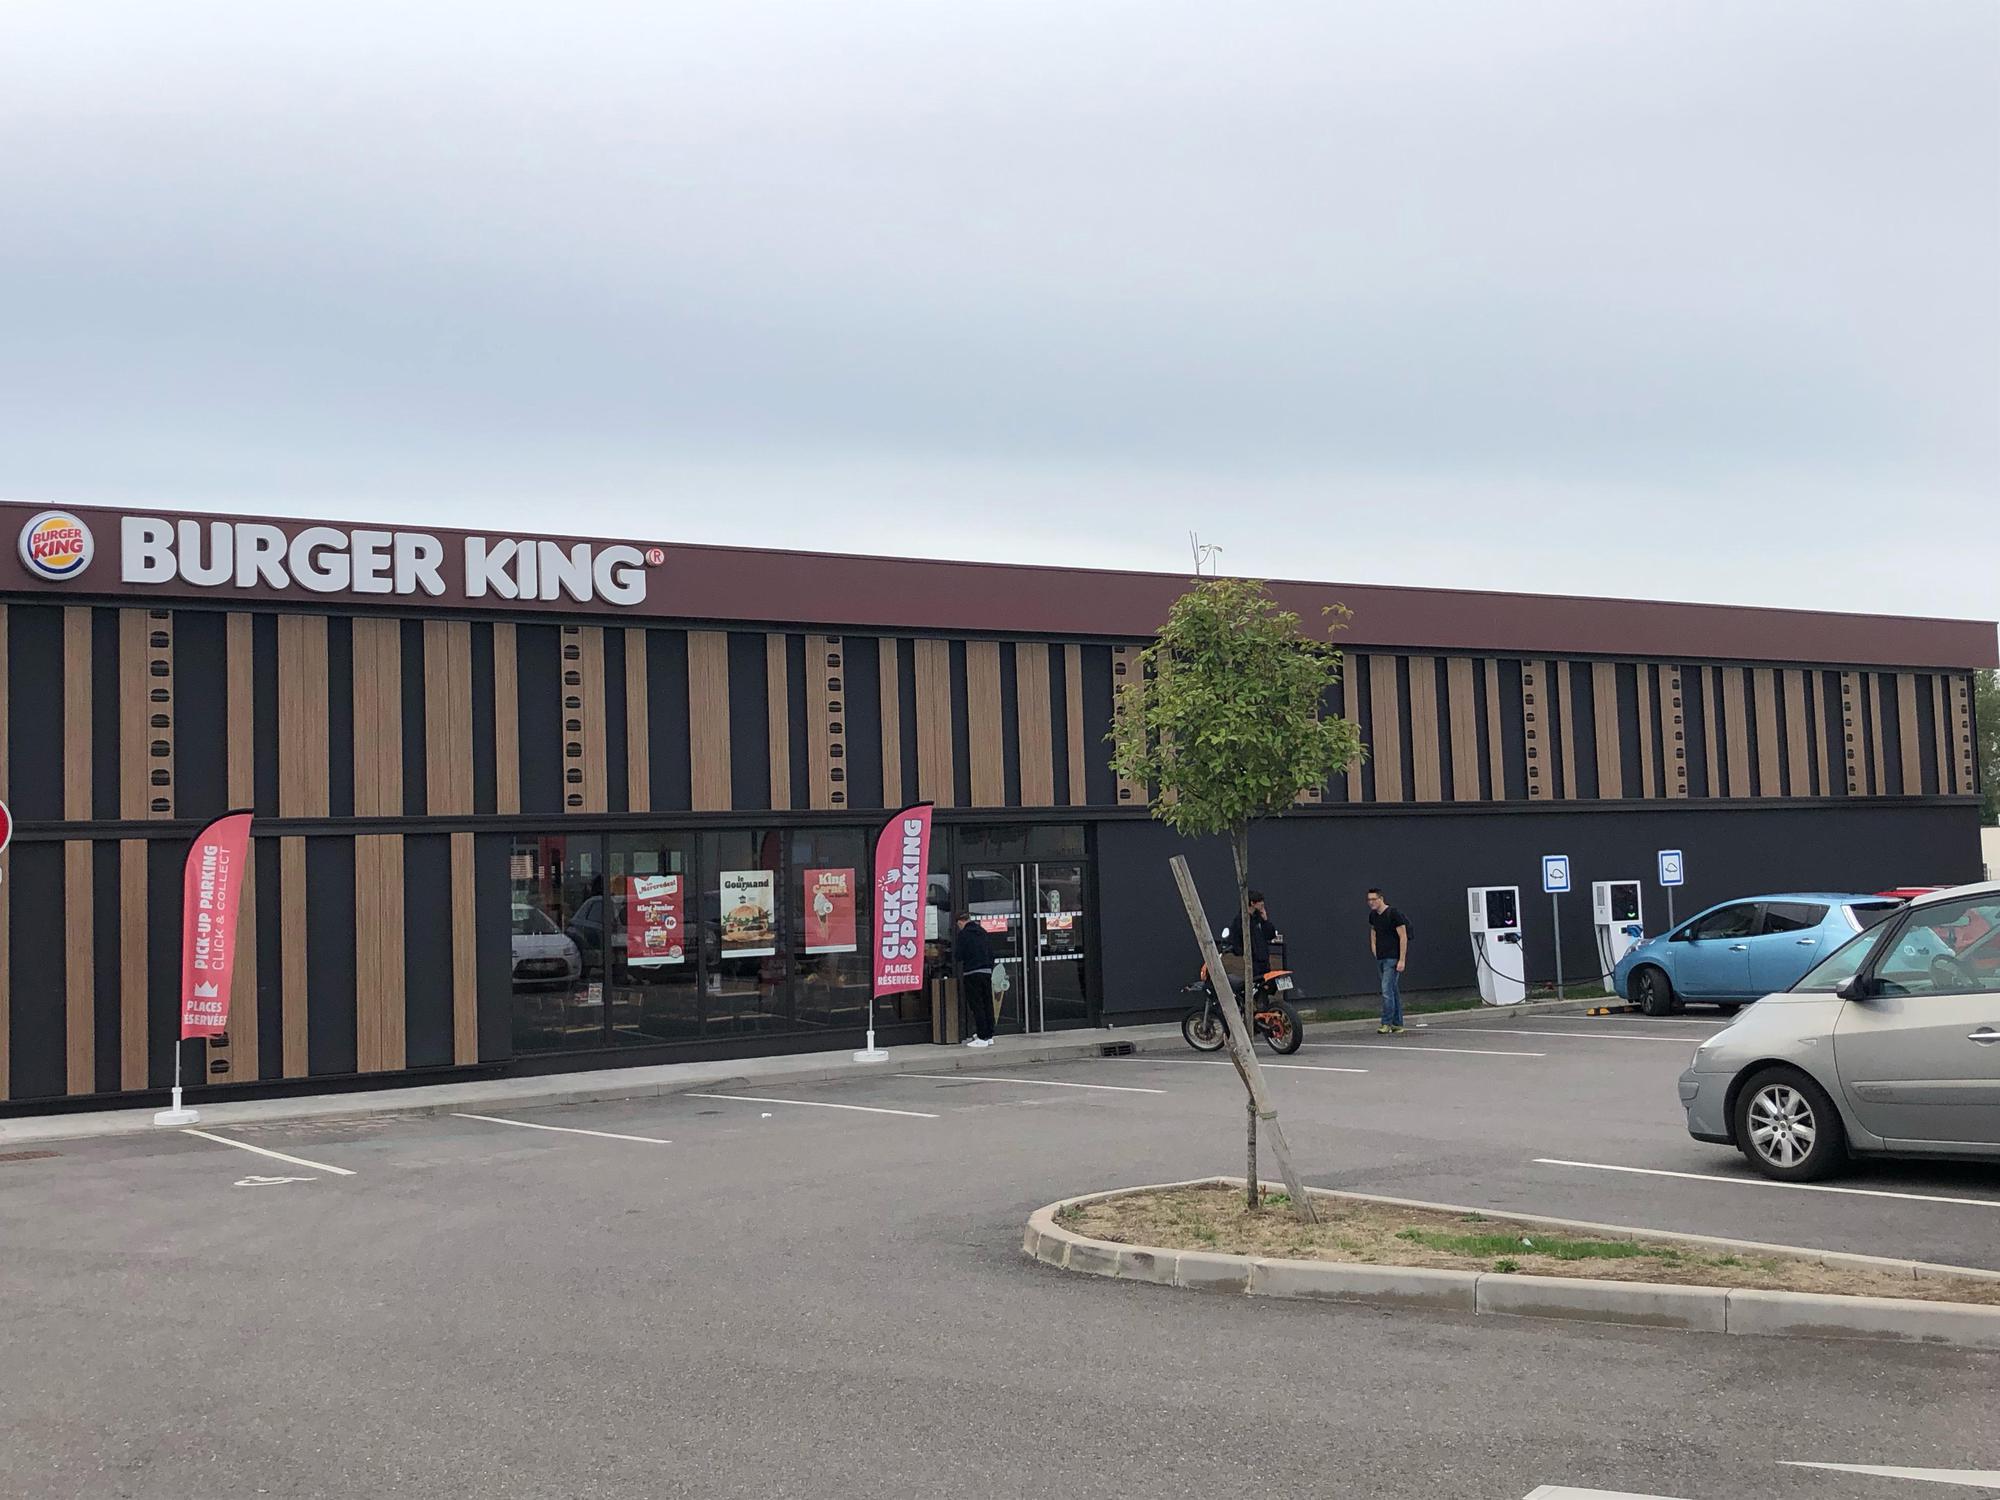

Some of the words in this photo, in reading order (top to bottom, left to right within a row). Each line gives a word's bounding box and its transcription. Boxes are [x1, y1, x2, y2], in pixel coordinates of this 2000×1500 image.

[33, 528, 82, 544] BURGER
[33, 539, 84, 560] KING
[121, 516, 445, 597] BURGER
[200, 845, 218, 909] PARKING
[217, 846, 231, 911] COLLECT
[724, 879, 769, 891] Gourmand
[216, 915, 225, 925] &
[882, 890, 900, 960] CLICK
[194, 912, 212, 970] PICK-UP
[212, 929, 225, 970] CLICK
[878, 974, 920, 985] RÉSERVÉES
[885, 964, 912, 974] PLACES
[186, 1000, 223, 1013] PLACES
